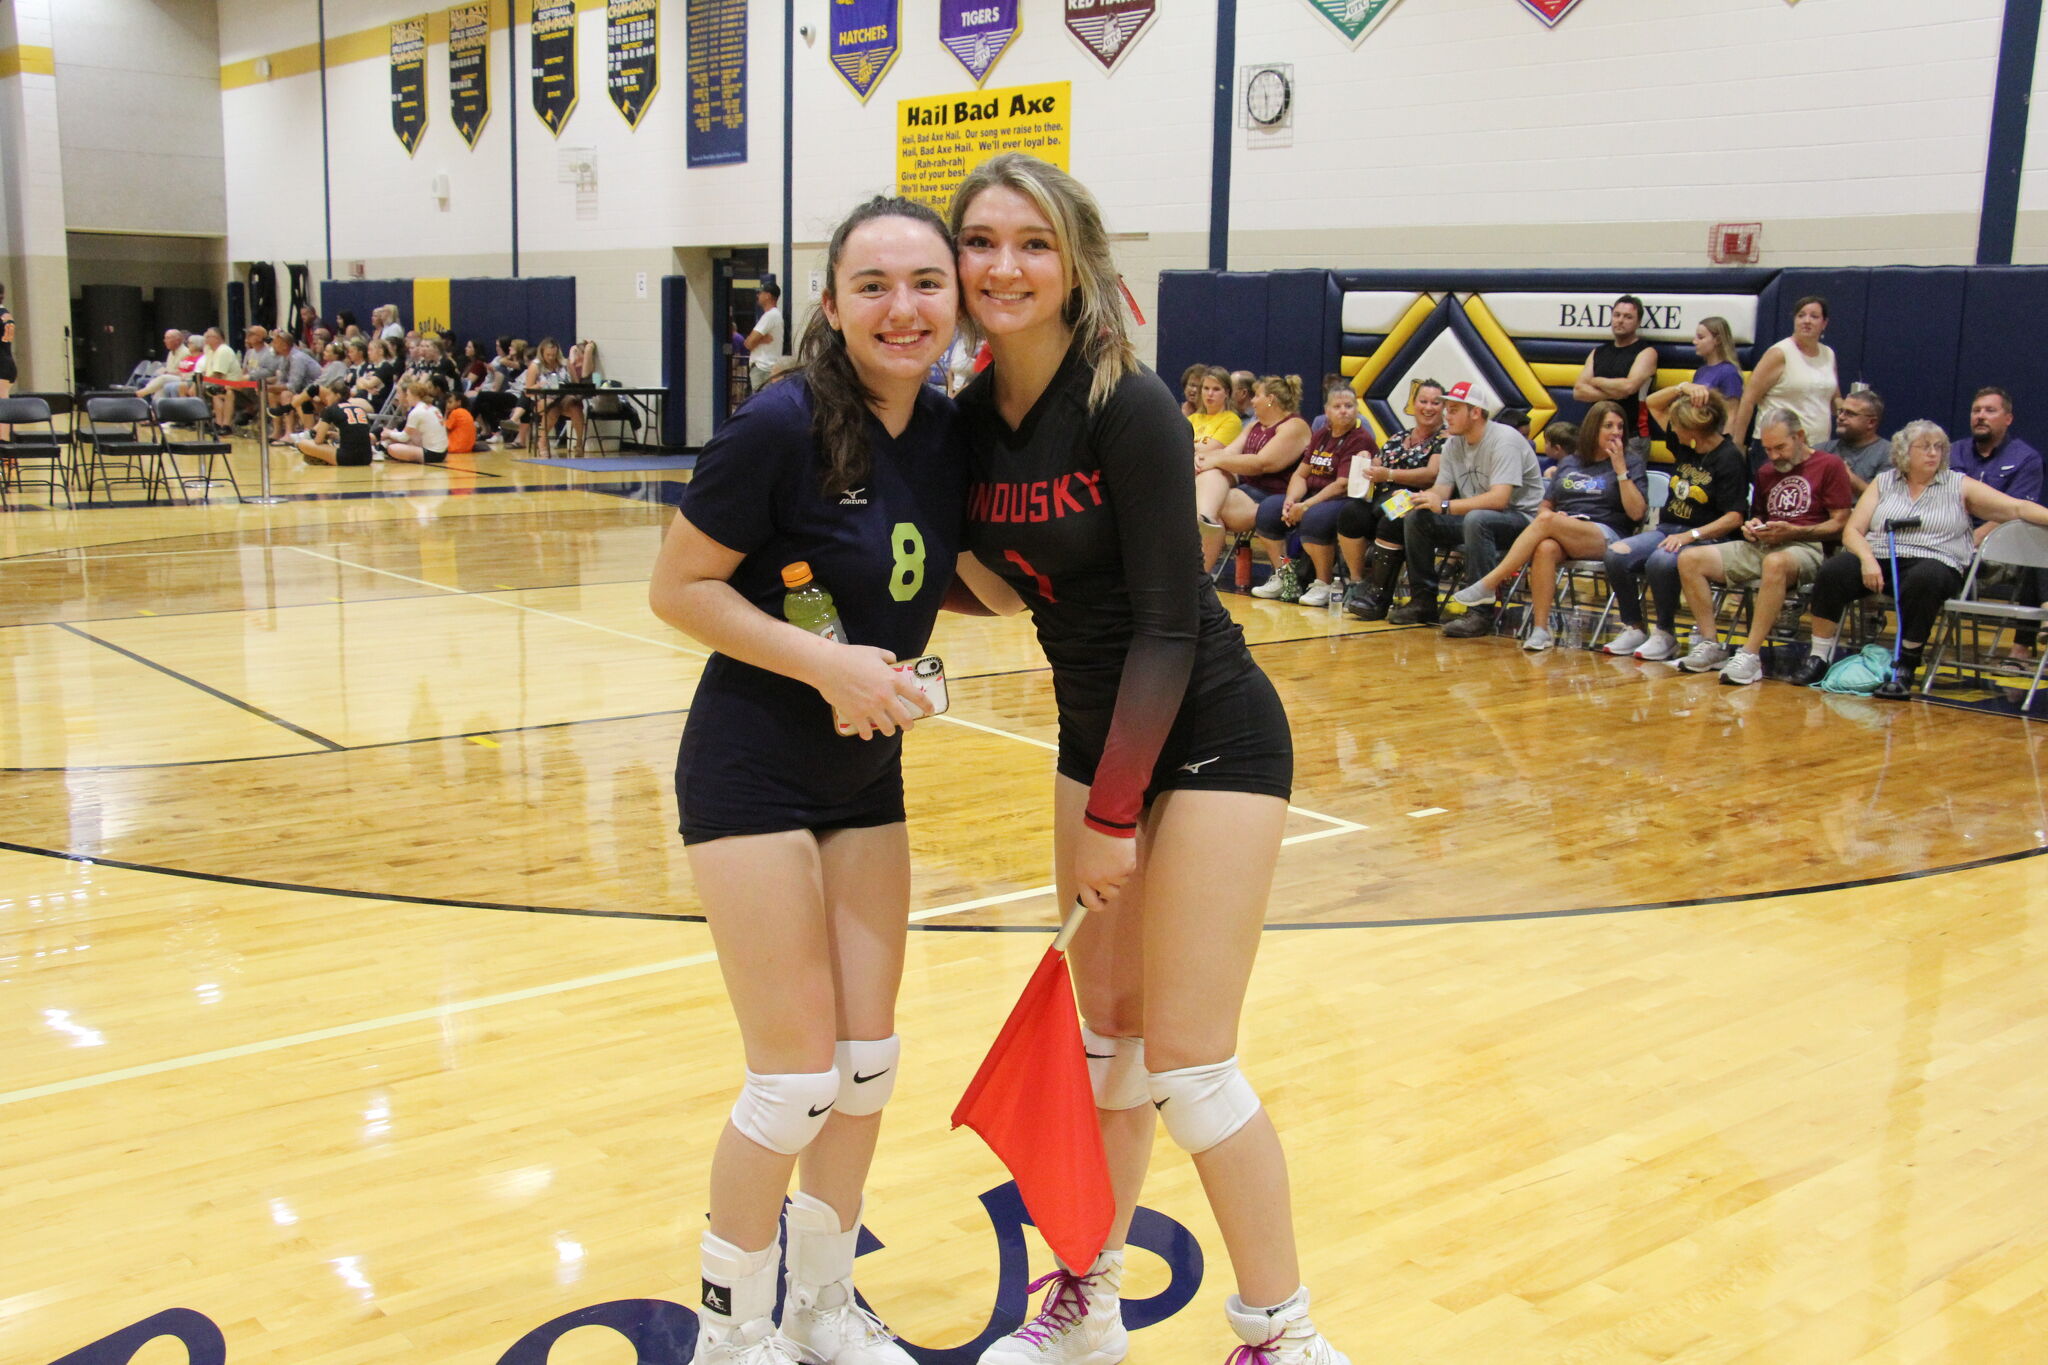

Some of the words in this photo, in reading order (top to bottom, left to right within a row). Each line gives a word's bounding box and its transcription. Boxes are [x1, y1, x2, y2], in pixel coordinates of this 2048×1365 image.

[961, 6, 1000, 27] TIGERS
[839, 24, 888, 46] HATCHETS
[907, 104, 948, 127] Hail
[954, 97, 998, 124] Bad
[1009, 94, 1056, 117] Axe
[917, 133, 930, 143] Bad
[931, 132, 944, 142] Axe
[945, 130, 960, 140] Hail.
[965, 129, 978, 139] Our
[980, 126, 998, 138] song
[1000, 127, 1011, 135] we
[1013, 124, 1032, 134] raise
[1034, 123, 1042, 133] to
[1044, 121, 1064, 132] thee.
[920, 146, 935, 156] Bad
[937, 145, 952, 154] Axe
[954, 143, 974, 152] Hail.
[979, 140, 1000, 151] We'll
[1002, 140, 1020, 149] ever
[1024, 136, 1045, 149] loyal
[1047, 135, 1061, 145] be.
[915, 156, 965, 170] (Rah-rah-rah)
[902, 171, 917, 181] Give
[919, 170, 926, 179] of
[928, 170, 946, 181] your
[947, 168, 969, 178] best.
[920, 183, 938, 192] have
[931, 195, 947, 205] Bad
[1640, 305, 1682, 330] XE
[343, 407, 369, 425] 12
[888, 522, 927, 602] 8
